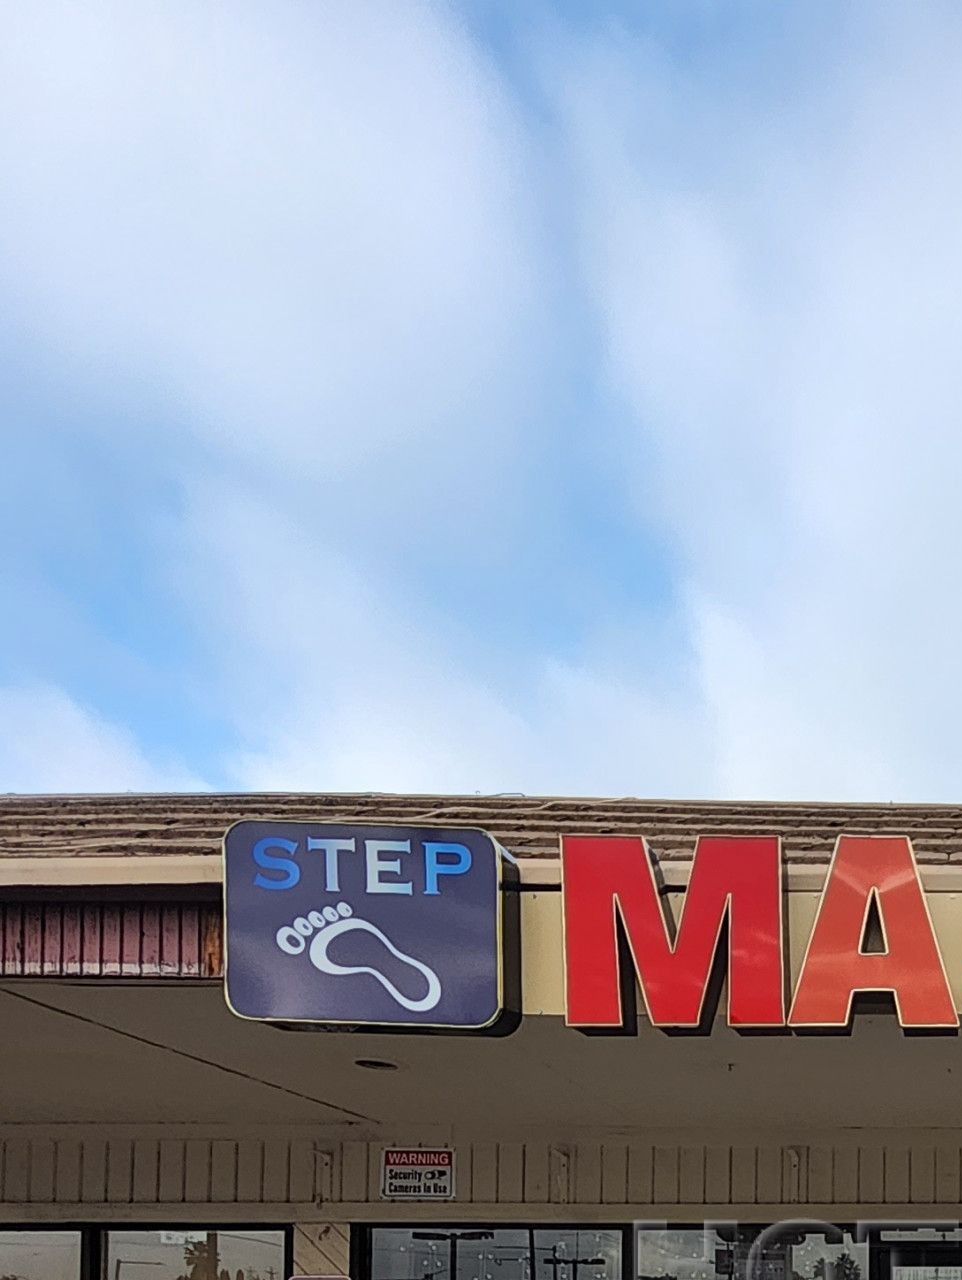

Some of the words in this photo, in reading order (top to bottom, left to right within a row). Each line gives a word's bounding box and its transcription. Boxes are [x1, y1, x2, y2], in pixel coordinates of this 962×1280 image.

[252, 836, 473, 896] STEP
[388, 1152, 449, 1164] WARNING
[388, 1168, 423, 1182] Security
[388, 1182, 422, 1194] Cameras
[433, 1182, 448, 1194] Use
